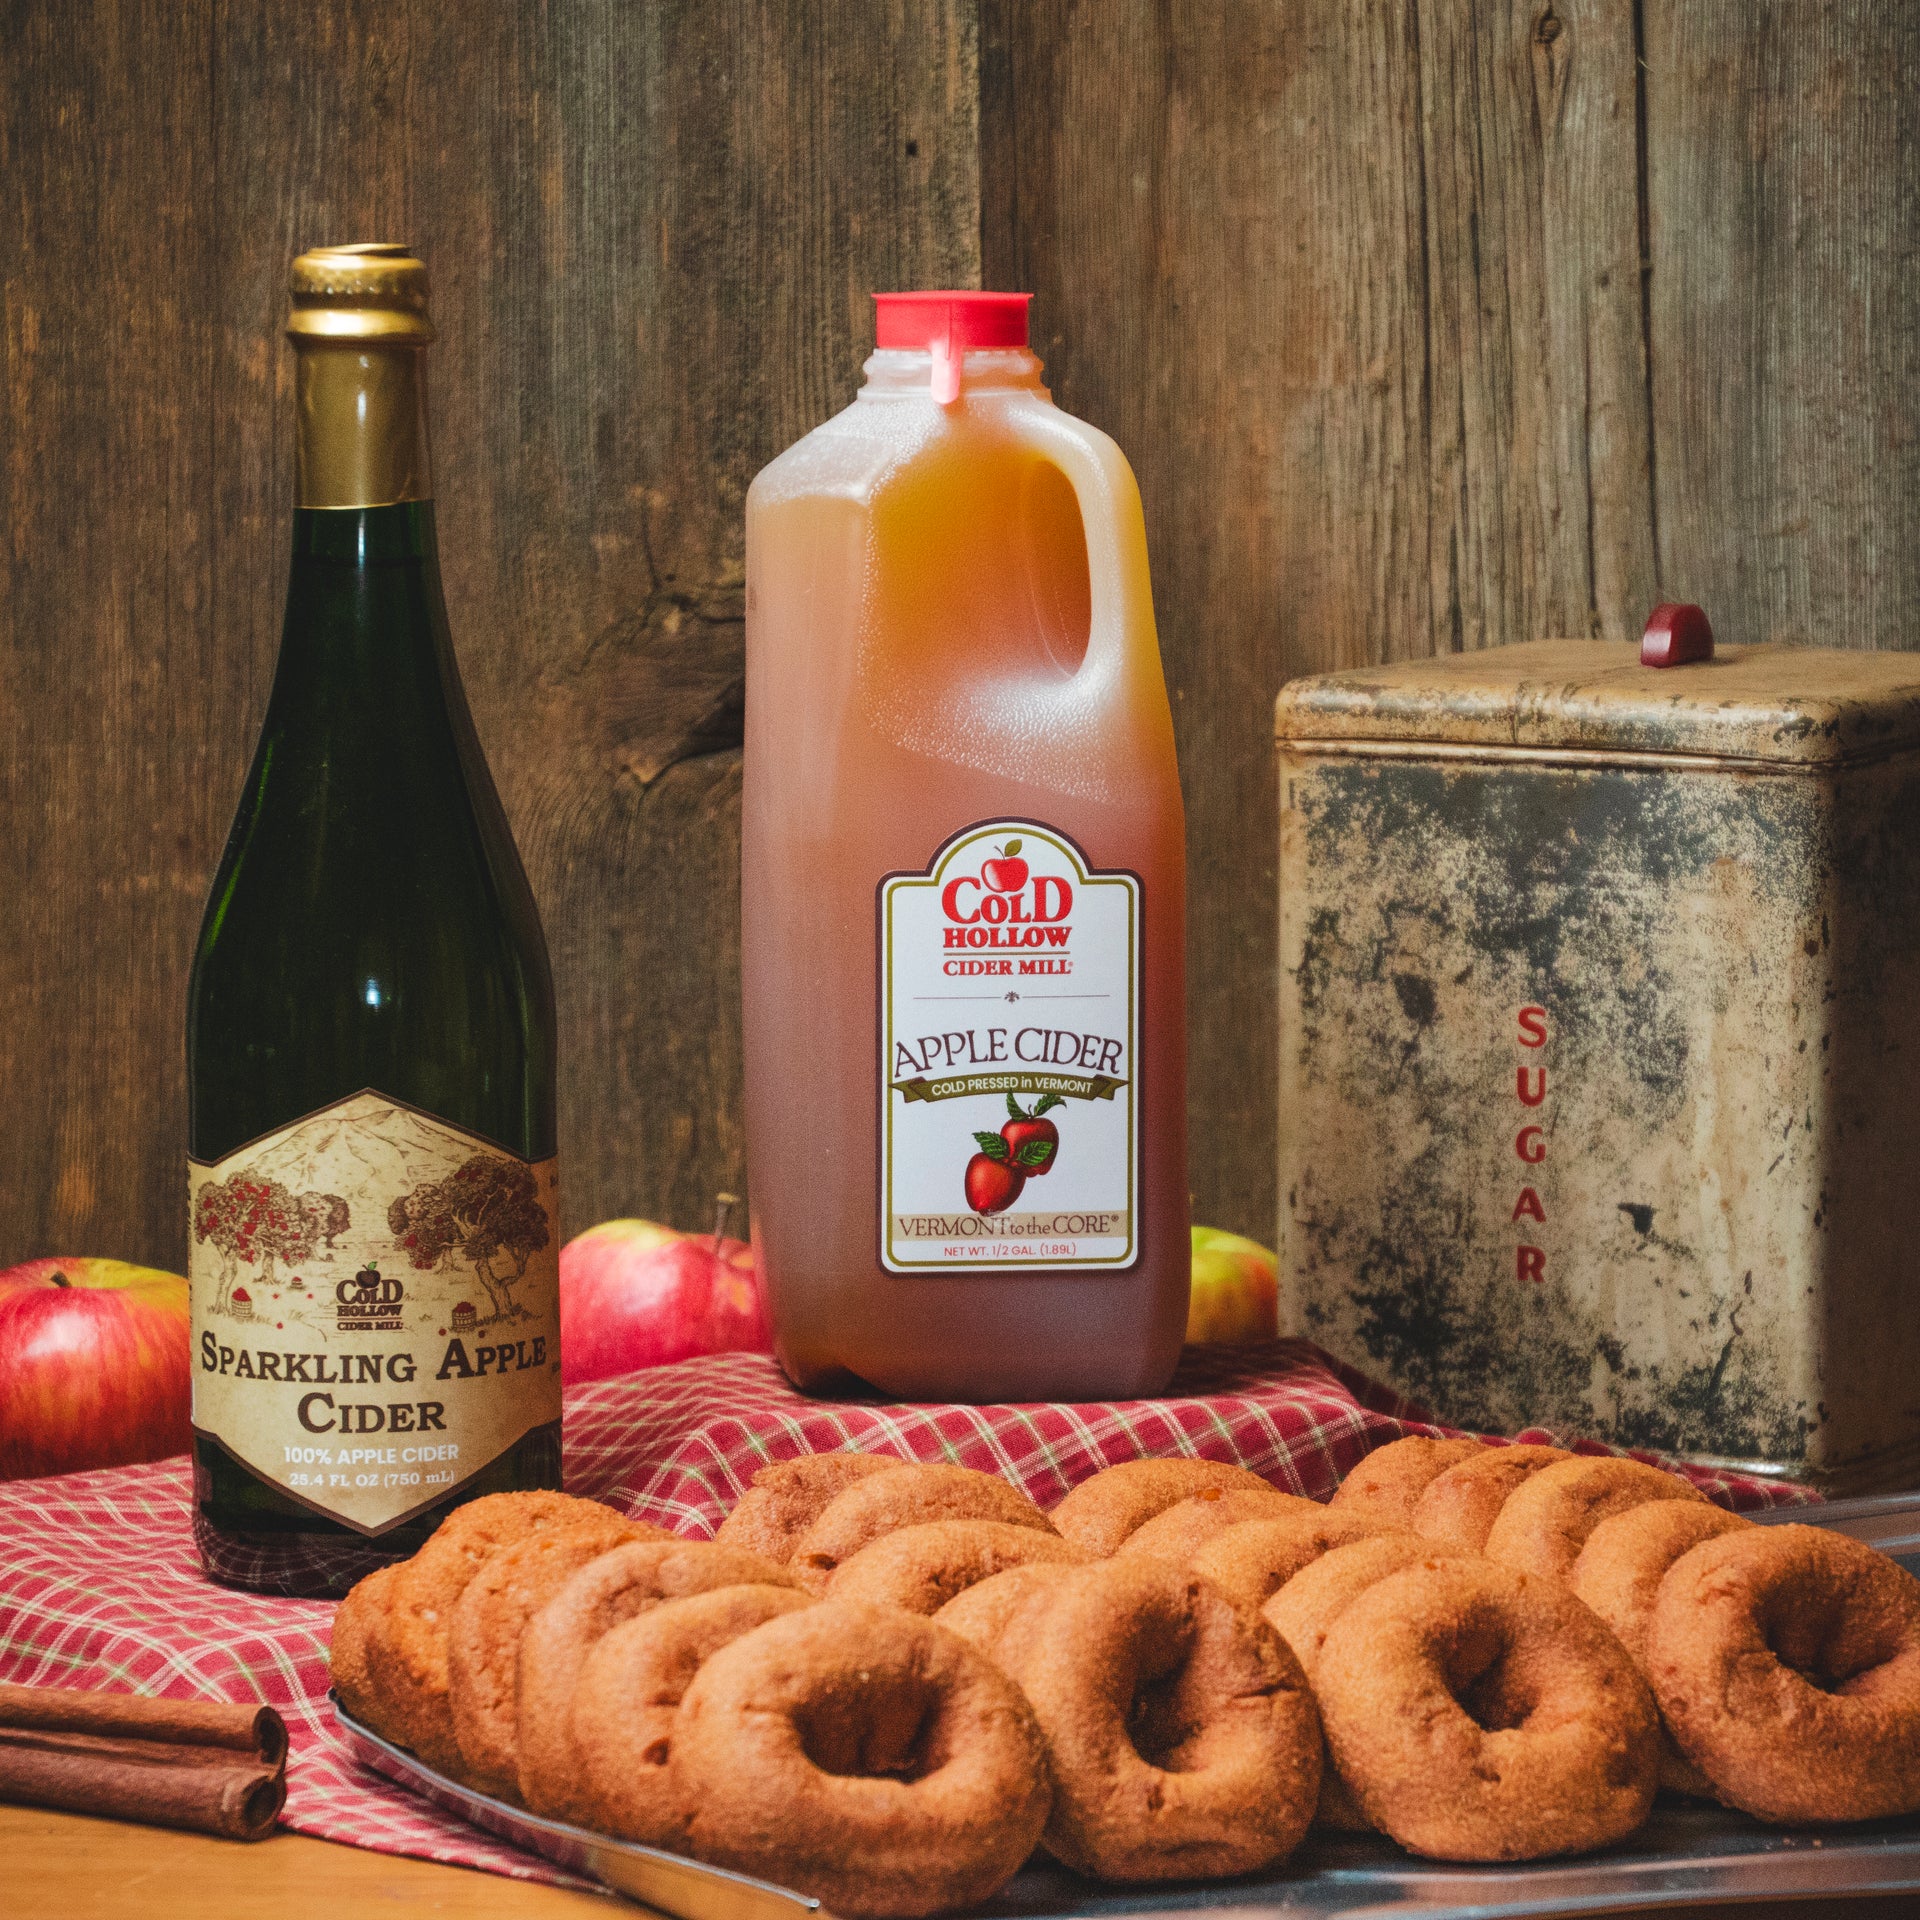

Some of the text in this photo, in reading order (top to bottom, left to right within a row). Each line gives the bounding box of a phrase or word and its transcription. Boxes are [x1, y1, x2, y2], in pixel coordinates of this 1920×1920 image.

[942, 876, 1073, 924] COLD
[943, 926, 1072, 948] HOLLOW
[943, 960, 1013, 976] CIDER
[894, 1027, 1123, 1078] APPLE CIDER
[931, 1076, 1093, 1096] COLD PRESSED in VERMONT
[1512, 1006, 1547, 1283] SUGAR
[899, 1216, 1010, 1236] VERMONT
[1010, 1222, 1025, 1235] to
[1026, 1216, 1051, 1235] the
[943, 1242, 1077, 1257] NET WT. 1/2 GAL. (1.89L)
[336, 1279, 404, 1305] COLD
[336, 1305, 403, 1317] HOLLOW
[337, 1322, 373, 1331] CIDER
[201, 1330, 547, 1384] SPARKLING APPLE
[297, 1392, 448, 1434] CIDER
[284, 1444, 459, 1465] 100% APPLE CIDER
[289, 1470, 456, 1489] 25.4 FL OZ (750 mL)
